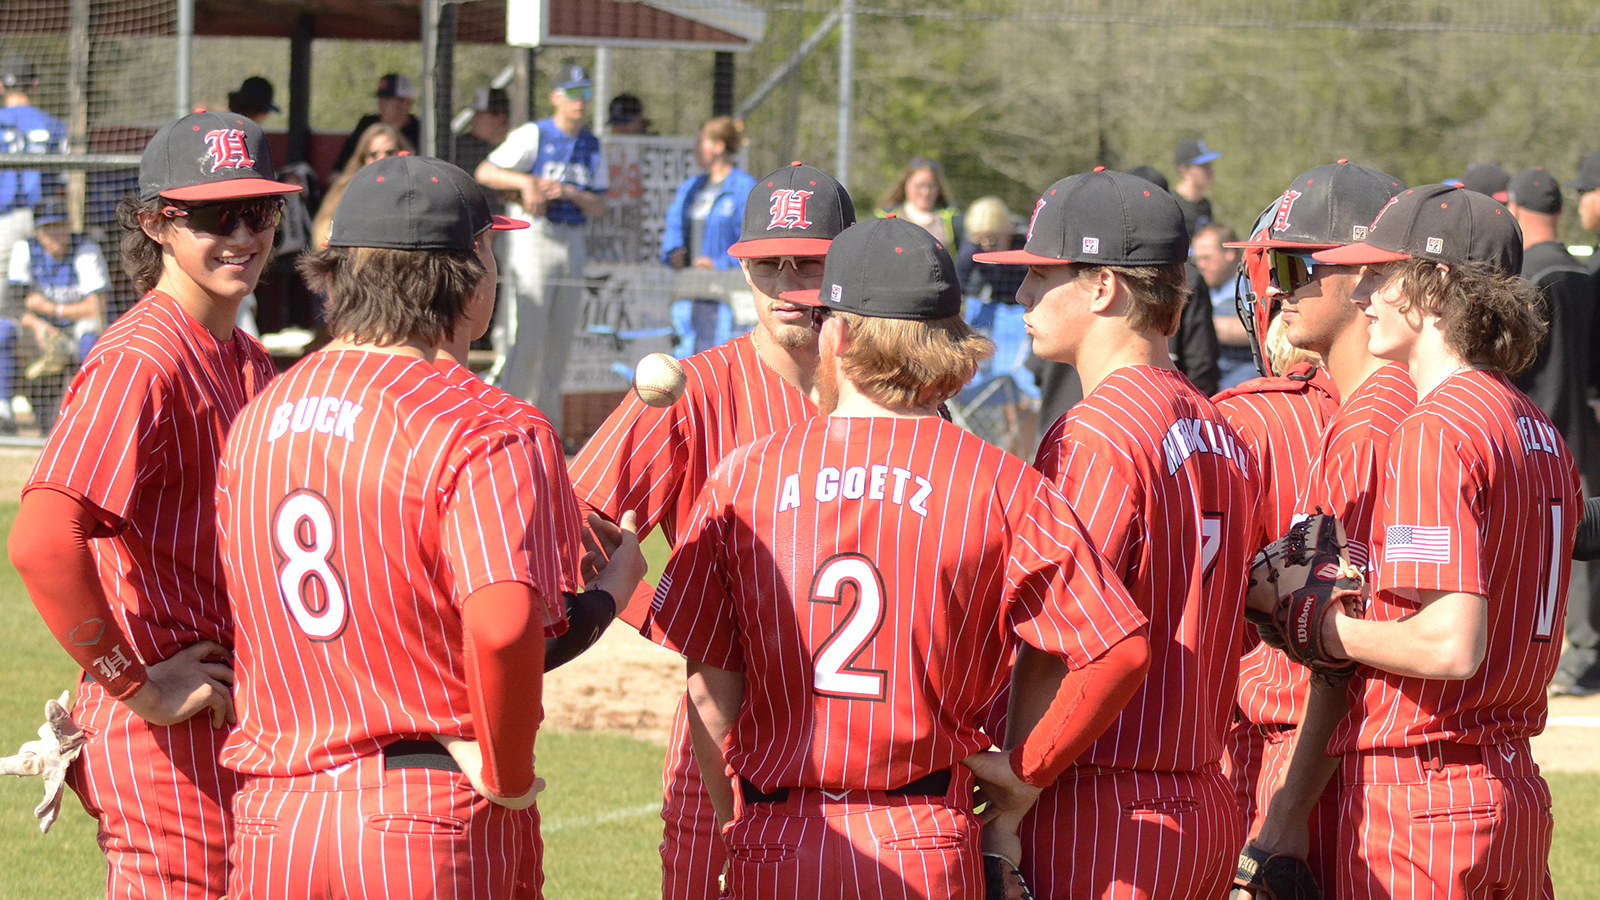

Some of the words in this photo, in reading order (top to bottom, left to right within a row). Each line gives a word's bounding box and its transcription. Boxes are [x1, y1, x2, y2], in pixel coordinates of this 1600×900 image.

[204, 128, 256, 173] H
[767, 188, 814, 231] H
[267, 396, 364, 443] BUCK
[1515, 415, 1561, 459] ELLY
[778, 472, 801, 513] A
[814, 464, 934, 518] GOETZ
[272, 487, 350, 643] 8
[808, 551, 888, 702] 2
[1297, 595, 1315, 644] Wilson
